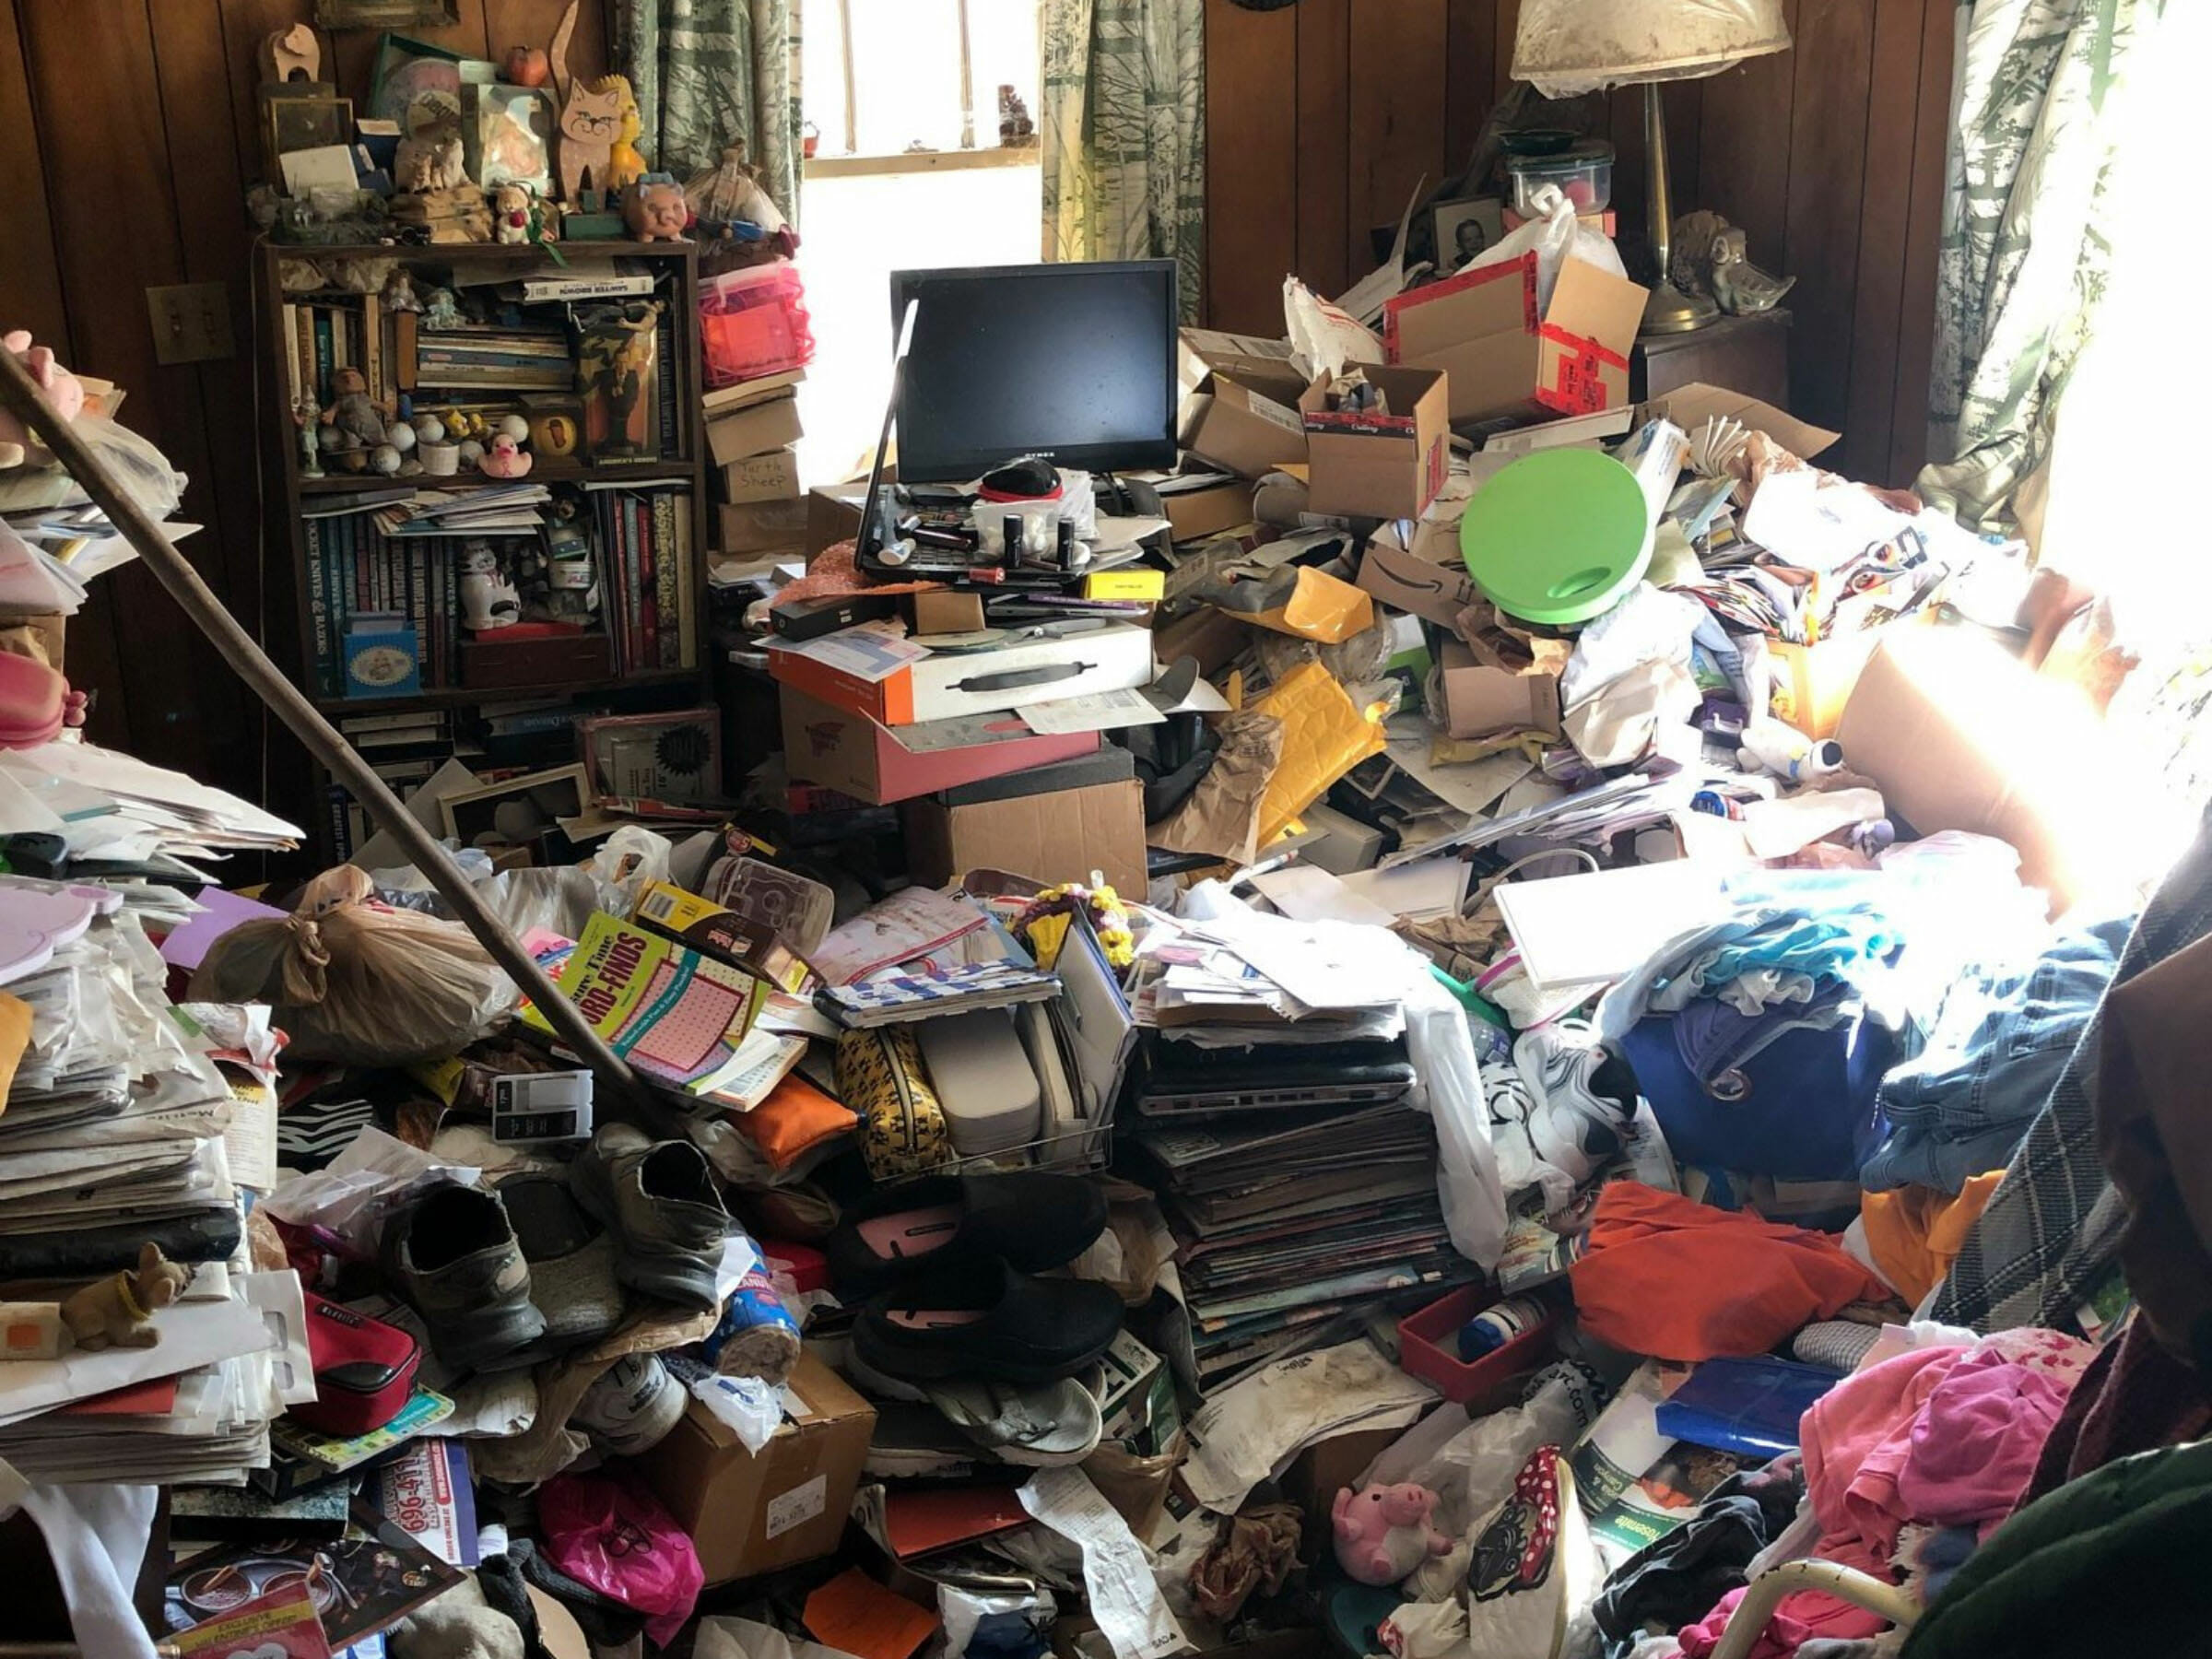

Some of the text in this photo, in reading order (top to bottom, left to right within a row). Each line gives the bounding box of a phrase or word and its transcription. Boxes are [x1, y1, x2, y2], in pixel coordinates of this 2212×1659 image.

[741, 474, 786, 489] Sheep
[311, 559, 324, 598] KNIVES
[312, 600, 326, 614] &
[315, 615, 329, 655] RAZORS
[586, 934, 615, 971] Time
[1614, 1514, 1662, 1543] Yosemite
